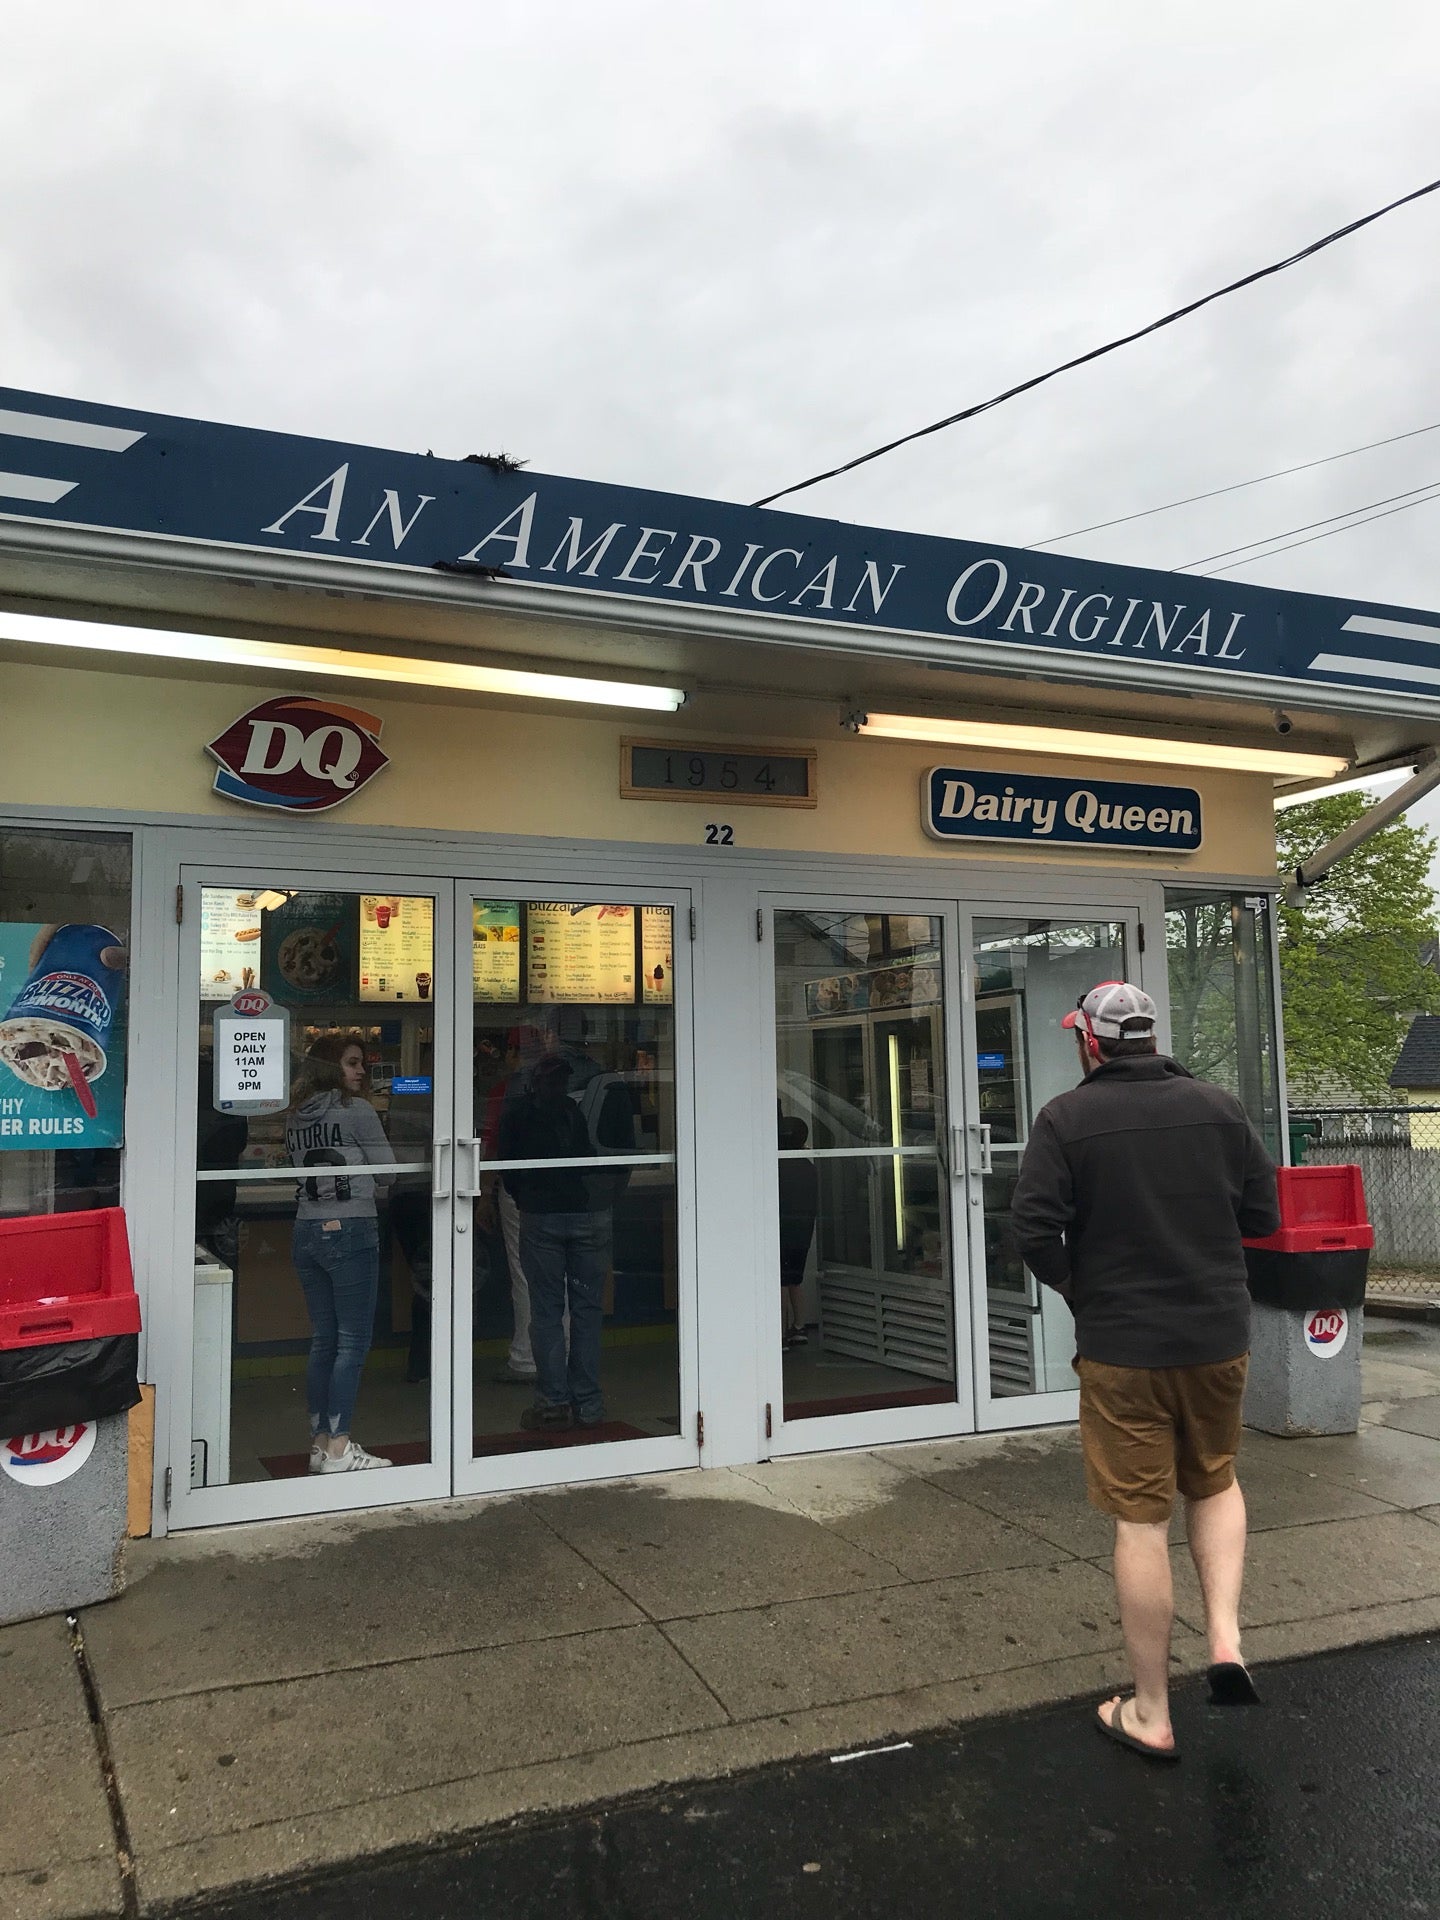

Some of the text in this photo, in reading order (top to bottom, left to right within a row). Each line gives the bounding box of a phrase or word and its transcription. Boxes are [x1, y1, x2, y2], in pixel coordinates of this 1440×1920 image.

[260, 462, 1247, 660] AN AMERICAN ORIGINAL
[663, 755, 776, 791] 1954
[939, 780, 1194, 835] Dairy Queen
[705, 823, 734, 846] 22
[20, 979, 110, 1020] BLIZZARD
[239, 998, 265, 1013] DQ
[233, 1032, 266, 1041] OPEN
[233, 1044, 267, 1054] DAILY
[234, 1056, 265, 1066] 11AM
[242, 1069, 258, 1078] TO
[238, 1081, 261, 1091] 9PM
[29, 1117, 85, 1135] RULES
[1313, 1315, 1339, 1336] DQ
